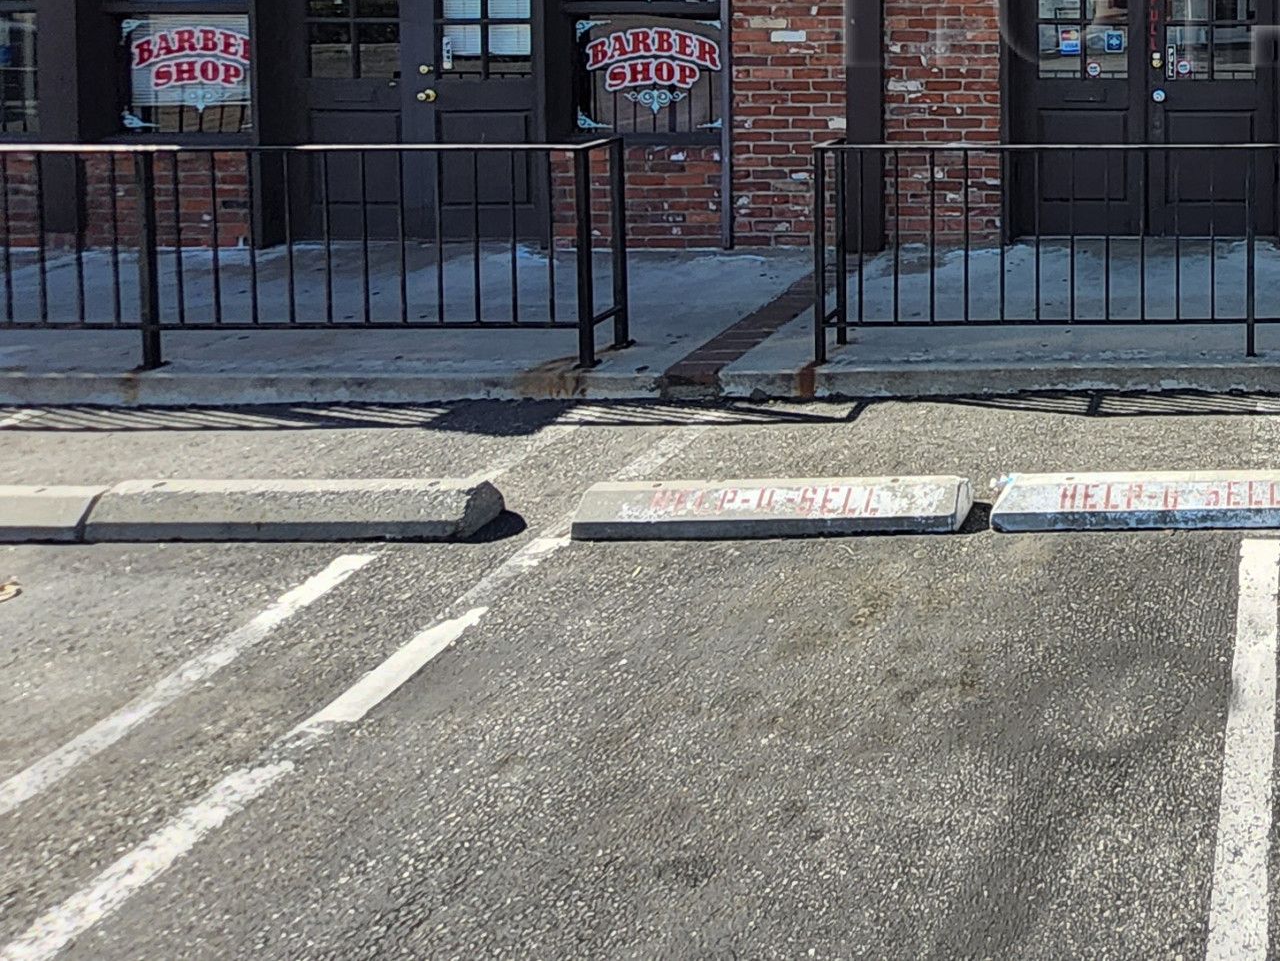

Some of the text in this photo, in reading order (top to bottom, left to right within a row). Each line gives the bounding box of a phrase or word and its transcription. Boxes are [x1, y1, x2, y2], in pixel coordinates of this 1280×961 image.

[586, 27, 721, 70] BARBER
[152, 57, 243, 90] SHOP
[605, 58, 699, 91] SHOP
